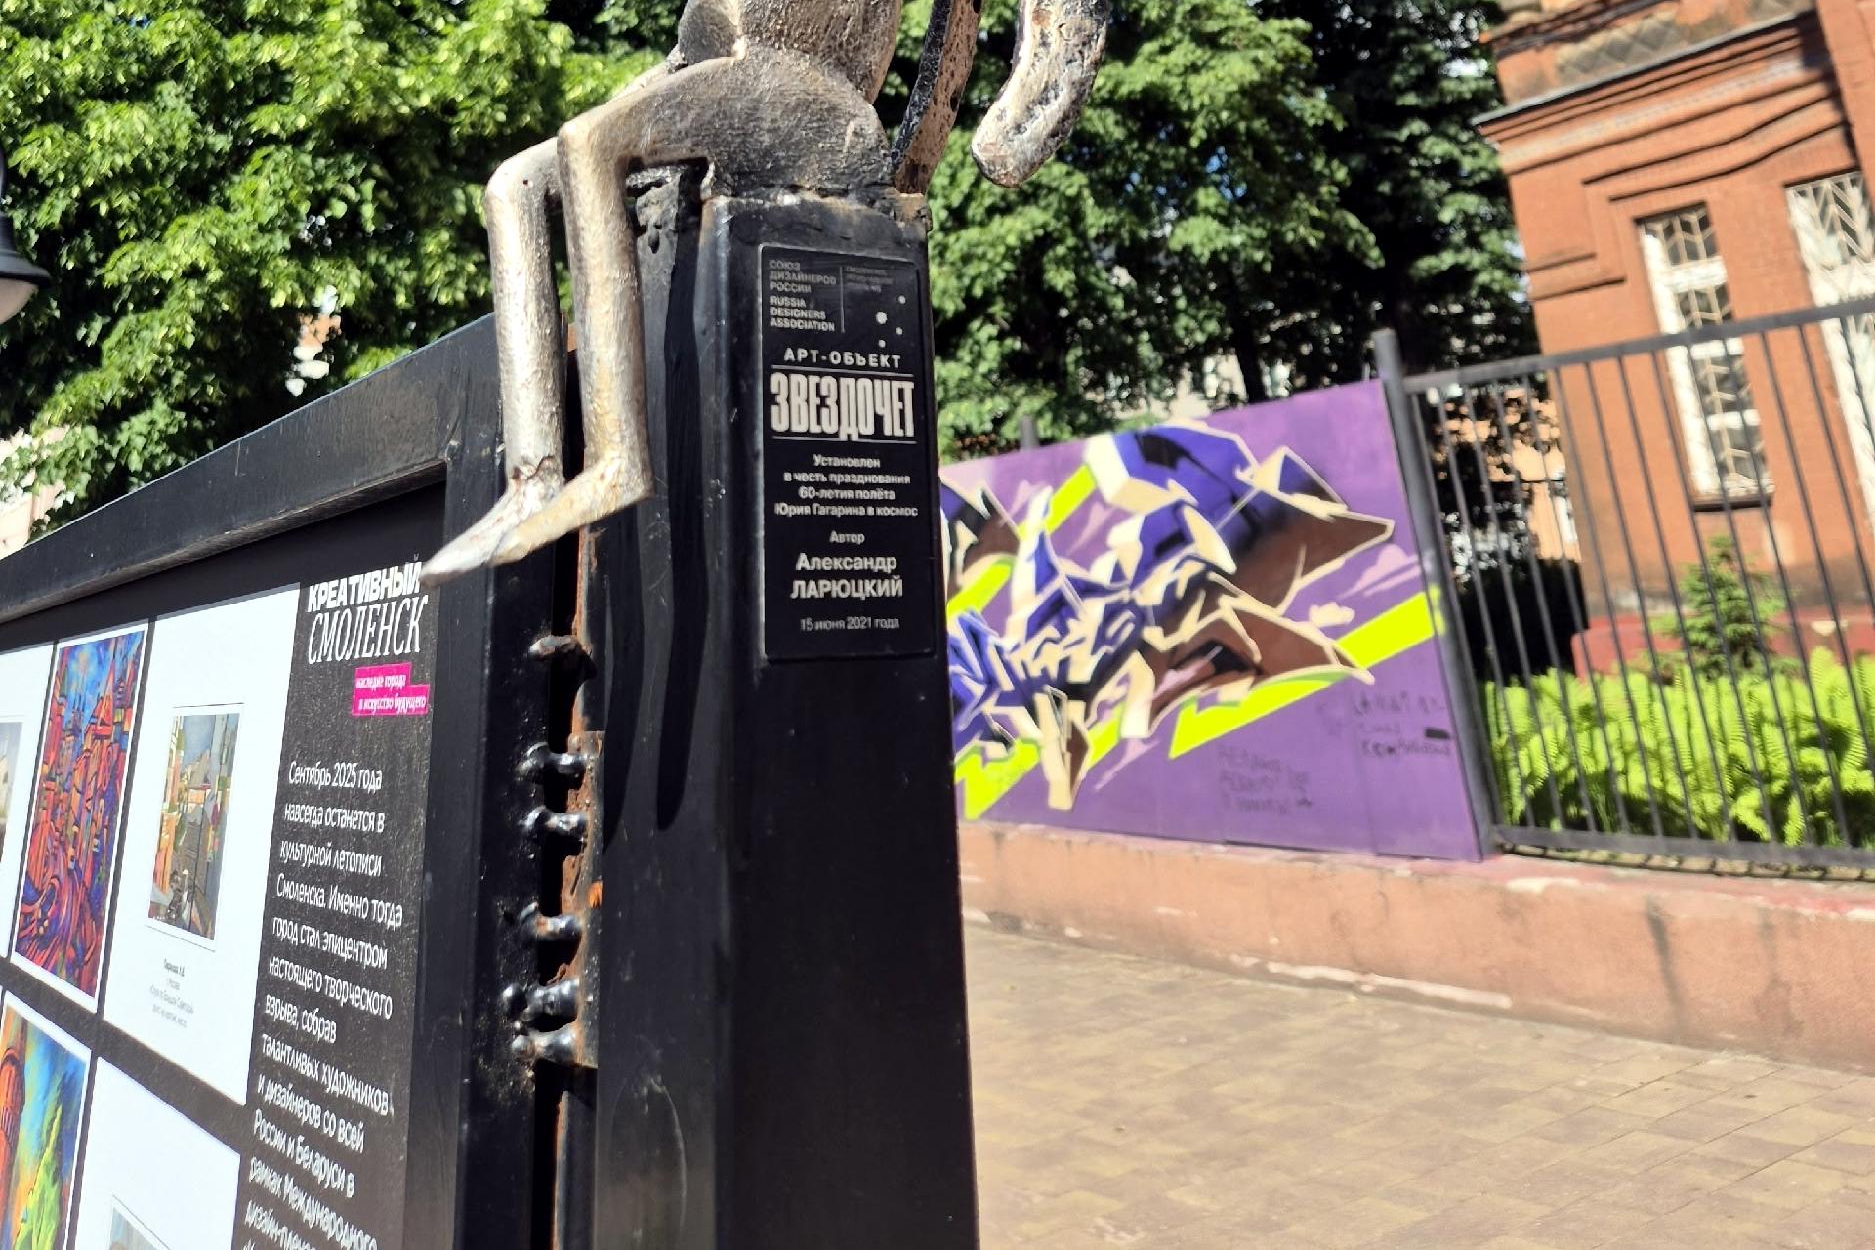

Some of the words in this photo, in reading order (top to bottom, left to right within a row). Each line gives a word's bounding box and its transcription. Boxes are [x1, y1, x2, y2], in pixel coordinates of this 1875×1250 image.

[769, 281, 812, 293] РОССИИ
[769, 295, 807, 308] RUSSIA
[769, 306, 827, 320] DESIGNERS
[769, 317, 835, 332] ASSOCIATION
[783, 347, 901, 368] АРТ-ОБЪЕКТ
[770, 372, 915, 441] ЗВЕЗДОЧЕТ
[812, 453, 881, 469] Установлен
[783, 472, 792, 482] в
[828, 474, 911, 485] празднования
[798, 486, 854, 499] 60-летия
[855, 487, 896, 500] полёта
[774, 502, 811, 518] Юрия
[866, 507, 875, 516] в
[876, 507, 918, 517] космос
[829, 530, 865, 545] Автор
[795, 552, 897, 573] Александр
[307, 553, 423, 612] КРЕАТИВНЫЙ
[790, 575, 903, 601] ЛАРЮЦКИЙ
[308, 594, 429, 664] СМОЛЕНСК
[846, 616, 872, 630] 2021
[873, 617, 900, 630] года
[288, 761, 331, 790] Сентябрь
[332, 762, 358, 788] 2025
[358, 769, 383, 794] года
[284, 803, 323, 829] навсегда
[324, 807, 376, 832] останется
[377, 812, 386, 833] в
[280, 840, 332, 868] культурной
[333, 849, 383, 877] летописи
[276, 873, 326, 908] Смоленска.
[328, 885, 368, 919] Именно
[371, 899, 403, 932] тогда
[272, 917, 299, 946] город
[300, 924, 320, 949] стал
[322, 931, 388, 970] эпицентром
[269, 956, 323, 992] настоящего
[324, 974, 394, 1020] творческого
[265, 994, 299, 1030] взрыва,
[301, 1007, 337, 1044] собрав
[262, 1033, 320, 1081] талантливых
[257, 1073, 266, 1095] и
[265, 1079, 321, 1129] дизайнеров
[323, 1109, 337, 1138] со
[337, 1119, 365, 1153] всей
[253, 1108, 287, 1154] России
[286, 1136, 296, 1159] и
[295, 1134, 346, 1191] Беларуси
[346, 1172, 355, 1198] в
